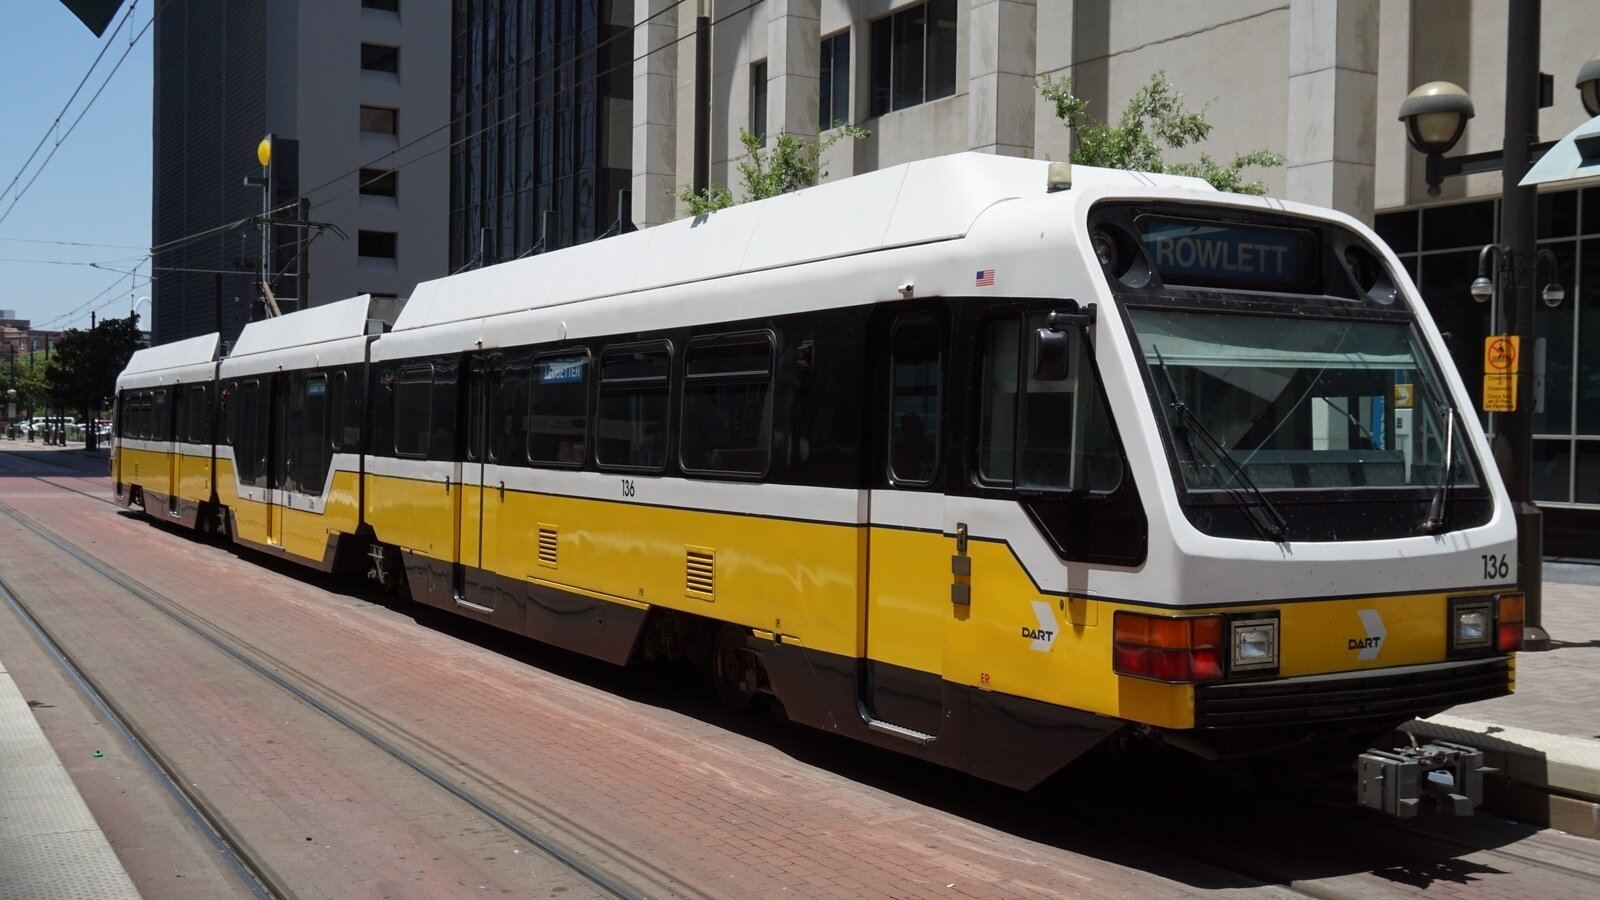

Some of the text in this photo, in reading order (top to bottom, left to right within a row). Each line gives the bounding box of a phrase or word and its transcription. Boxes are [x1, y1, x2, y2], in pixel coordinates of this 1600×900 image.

[1155, 236, 1289, 274] ROWLETT
[622, 479, 635, 497] 136
[1481, 554, 1509, 580] 136
[1022, 627, 1053, 642] DART
[1348, 637, 1381, 650] DART
[980, 672, 990, 685] ER
